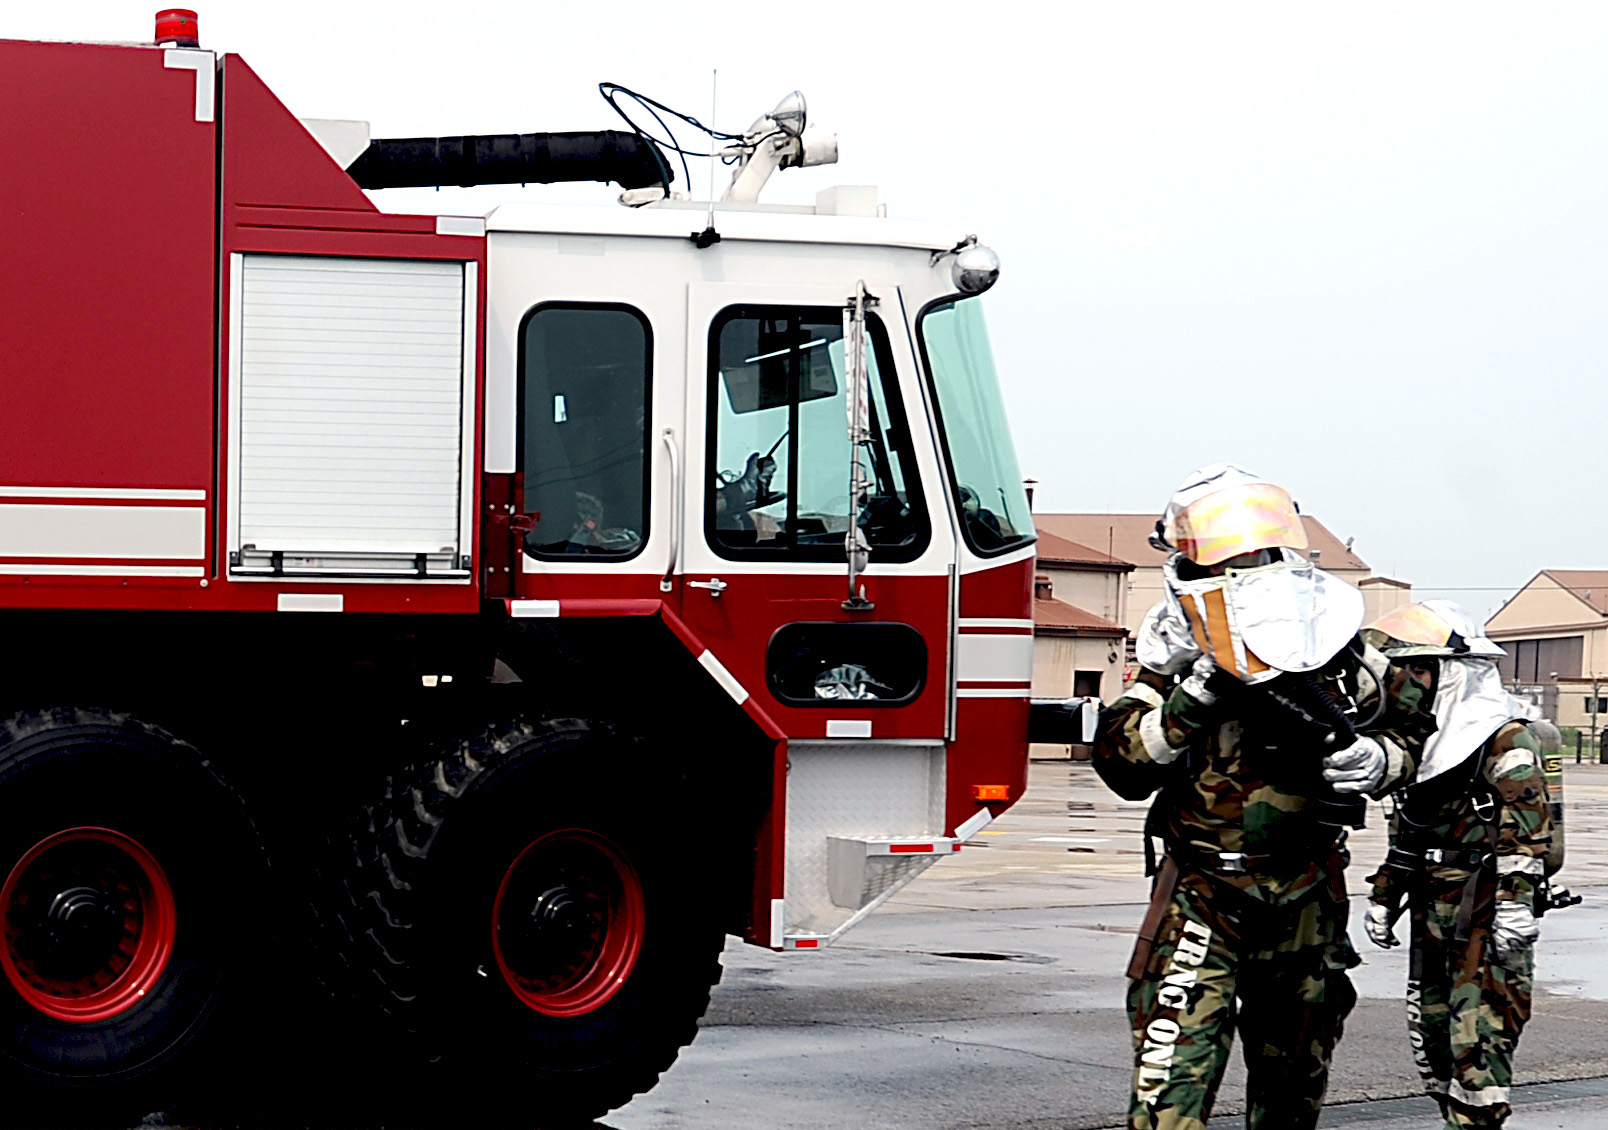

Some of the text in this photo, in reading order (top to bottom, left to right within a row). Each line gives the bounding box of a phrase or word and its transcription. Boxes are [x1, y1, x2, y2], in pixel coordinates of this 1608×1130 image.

[1137, 920, 1212, 1106] TRNG ONLY
[1407, 980, 1422, 1023] NG
